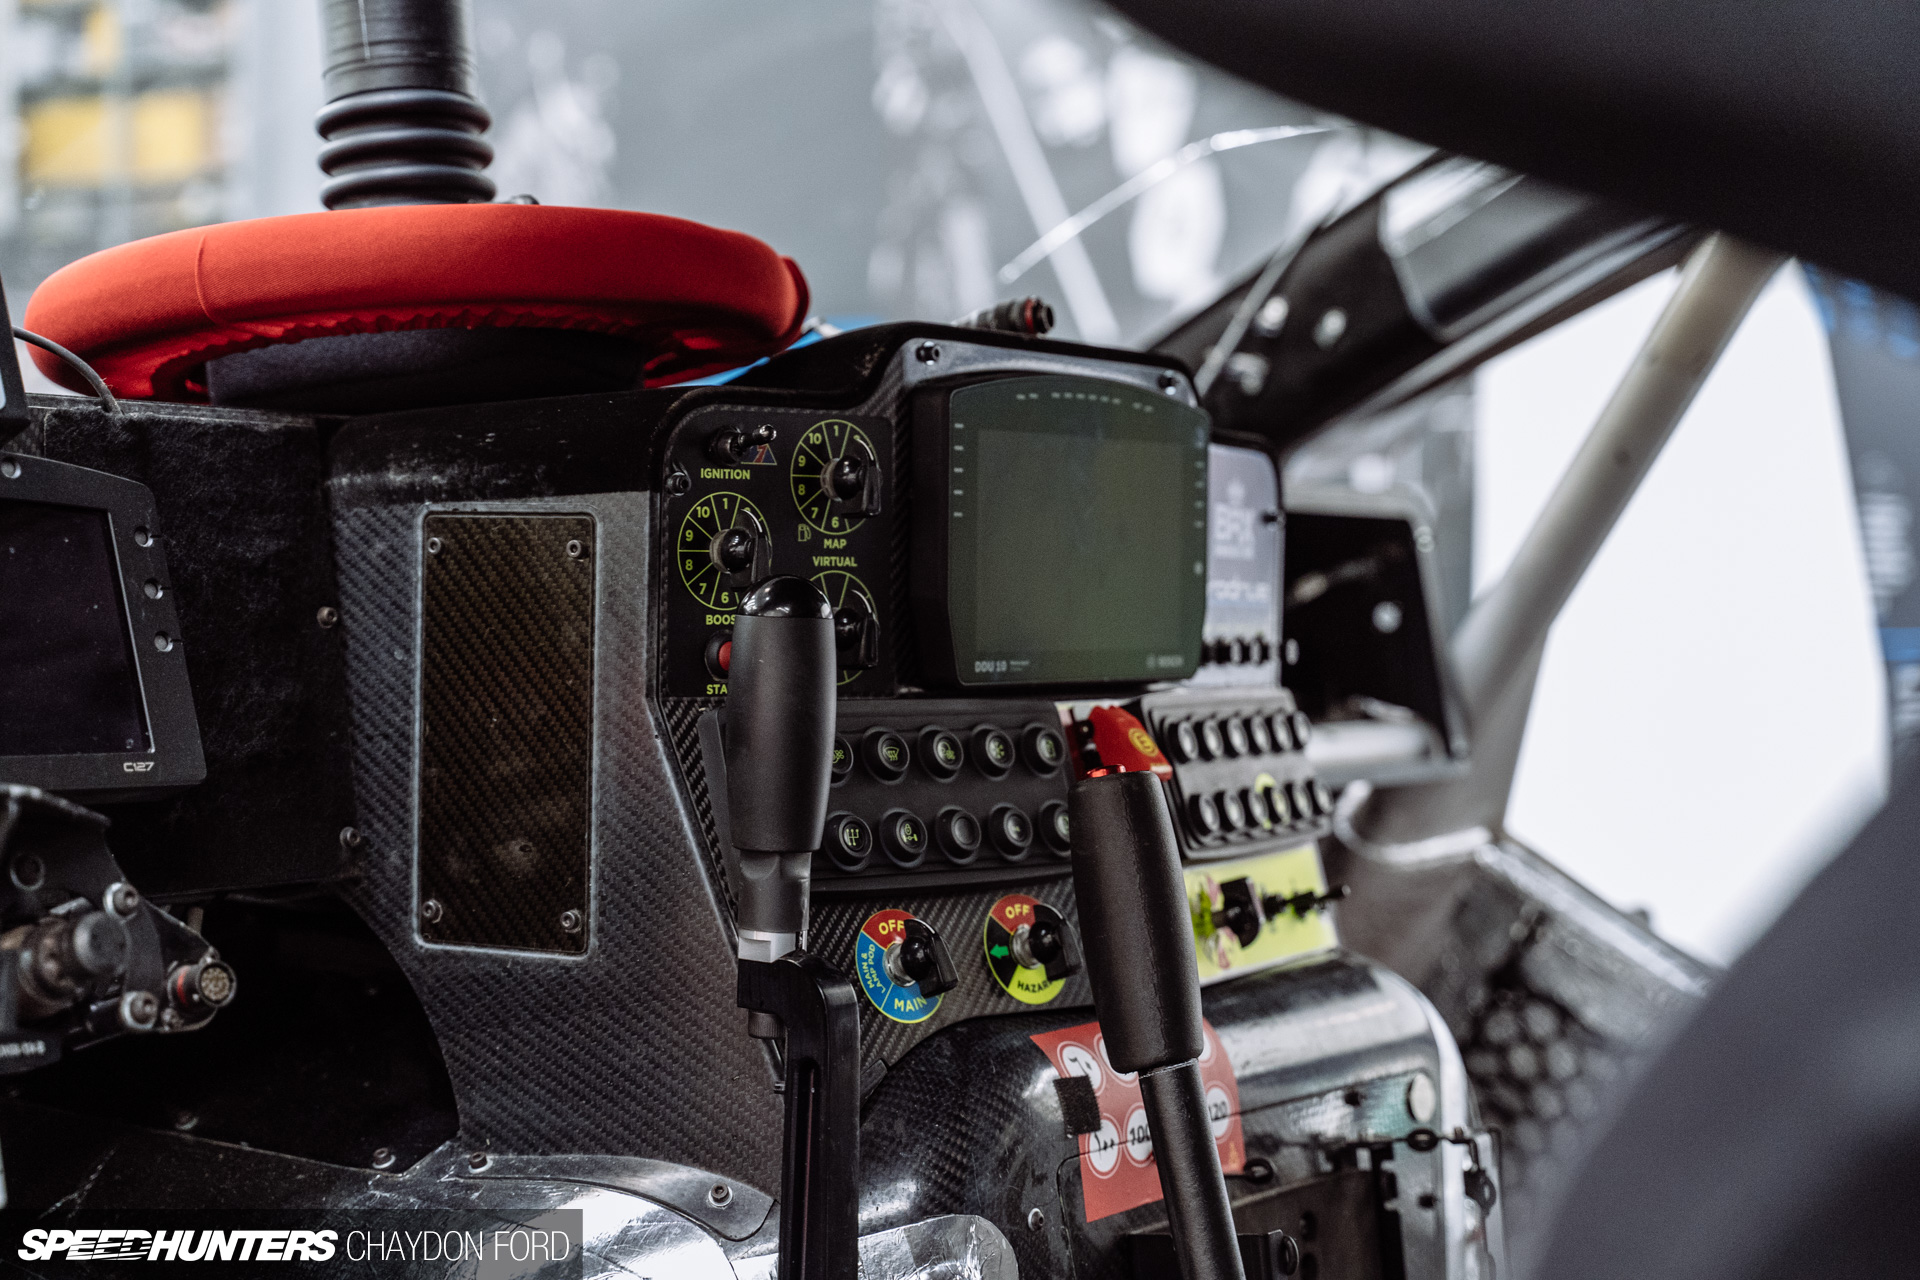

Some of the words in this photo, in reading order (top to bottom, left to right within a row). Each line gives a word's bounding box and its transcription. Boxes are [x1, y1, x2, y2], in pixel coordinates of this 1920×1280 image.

[833, 424, 839, 436] 1
[808, 432, 822, 444] 10
[798, 455, 806, 467] 9
[700, 468, 750, 480] IGNITION
[798, 484, 806, 496] 8
[722, 498, 728, 509] 1
[696, 506, 710, 518] 10
[811, 507, 819, 518] 7
[831, 516, 840, 528] 6
[685, 530, 693, 542] 9
[823, 538, 847, 549] MAP
[685, 559, 693, 571] 8
[812, 556, 857, 567] VIRTUAL
[699, 583, 707, 594] 7
[721, 592, 729, 604] 6
[705, 614, 736, 625] BOOS
[706, 684, 728, 695] STA
[123, 761, 155, 772] C127
[1005, 903, 1030, 919] OFF
[878, 919, 905, 935] OFF
[862, 962, 875, 988] MAIN
[870, 967, 886, 994] LAMP
[1017, 980, 1052, 993] HAZAR
[894, 997, 927, 1012] MAIN
